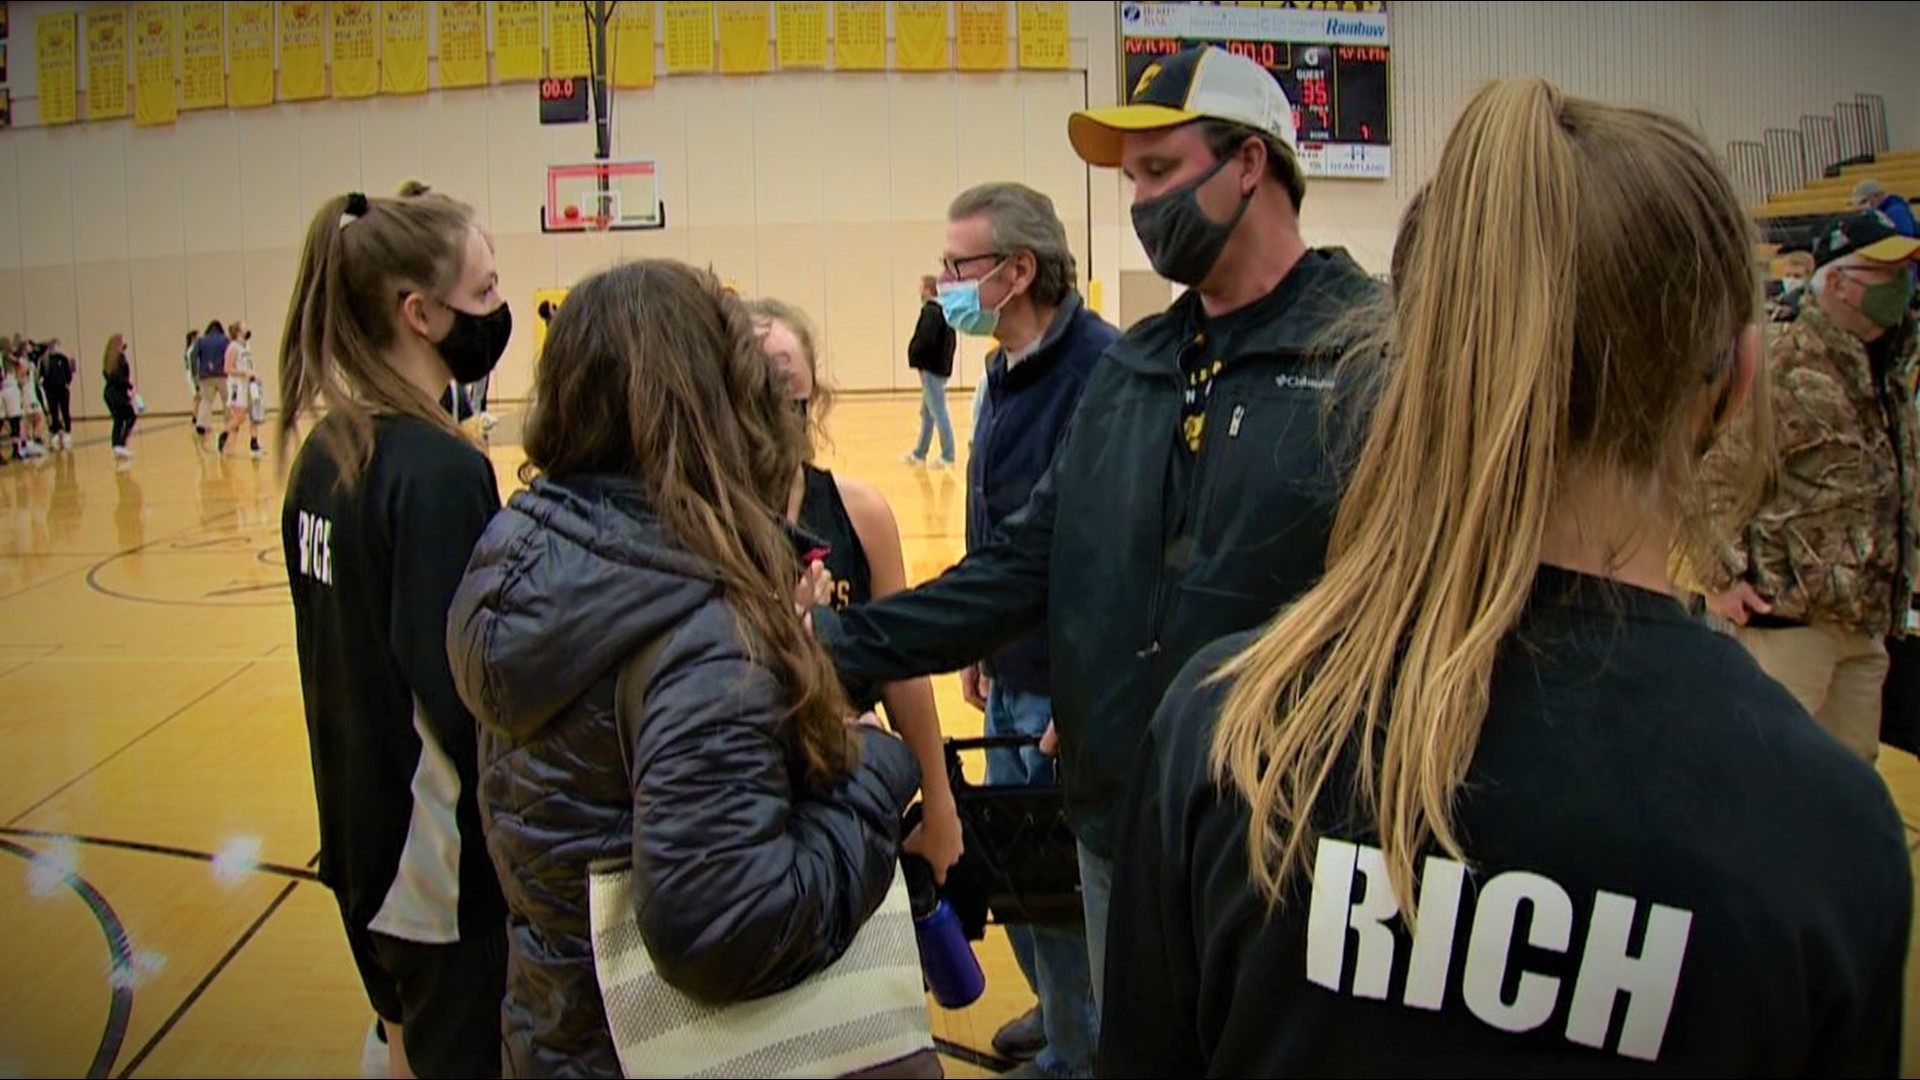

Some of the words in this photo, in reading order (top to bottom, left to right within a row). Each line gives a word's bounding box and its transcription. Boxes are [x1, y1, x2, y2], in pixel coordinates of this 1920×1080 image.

[1326, 17, 1385, 36] Rainbow
[1296, 69, 1324, 80] GUEST
[543, 79, 573, 98] 00.0
[1303, 77, 1327, 104] 35
[1306, 837, 1694, 1062] RICH
